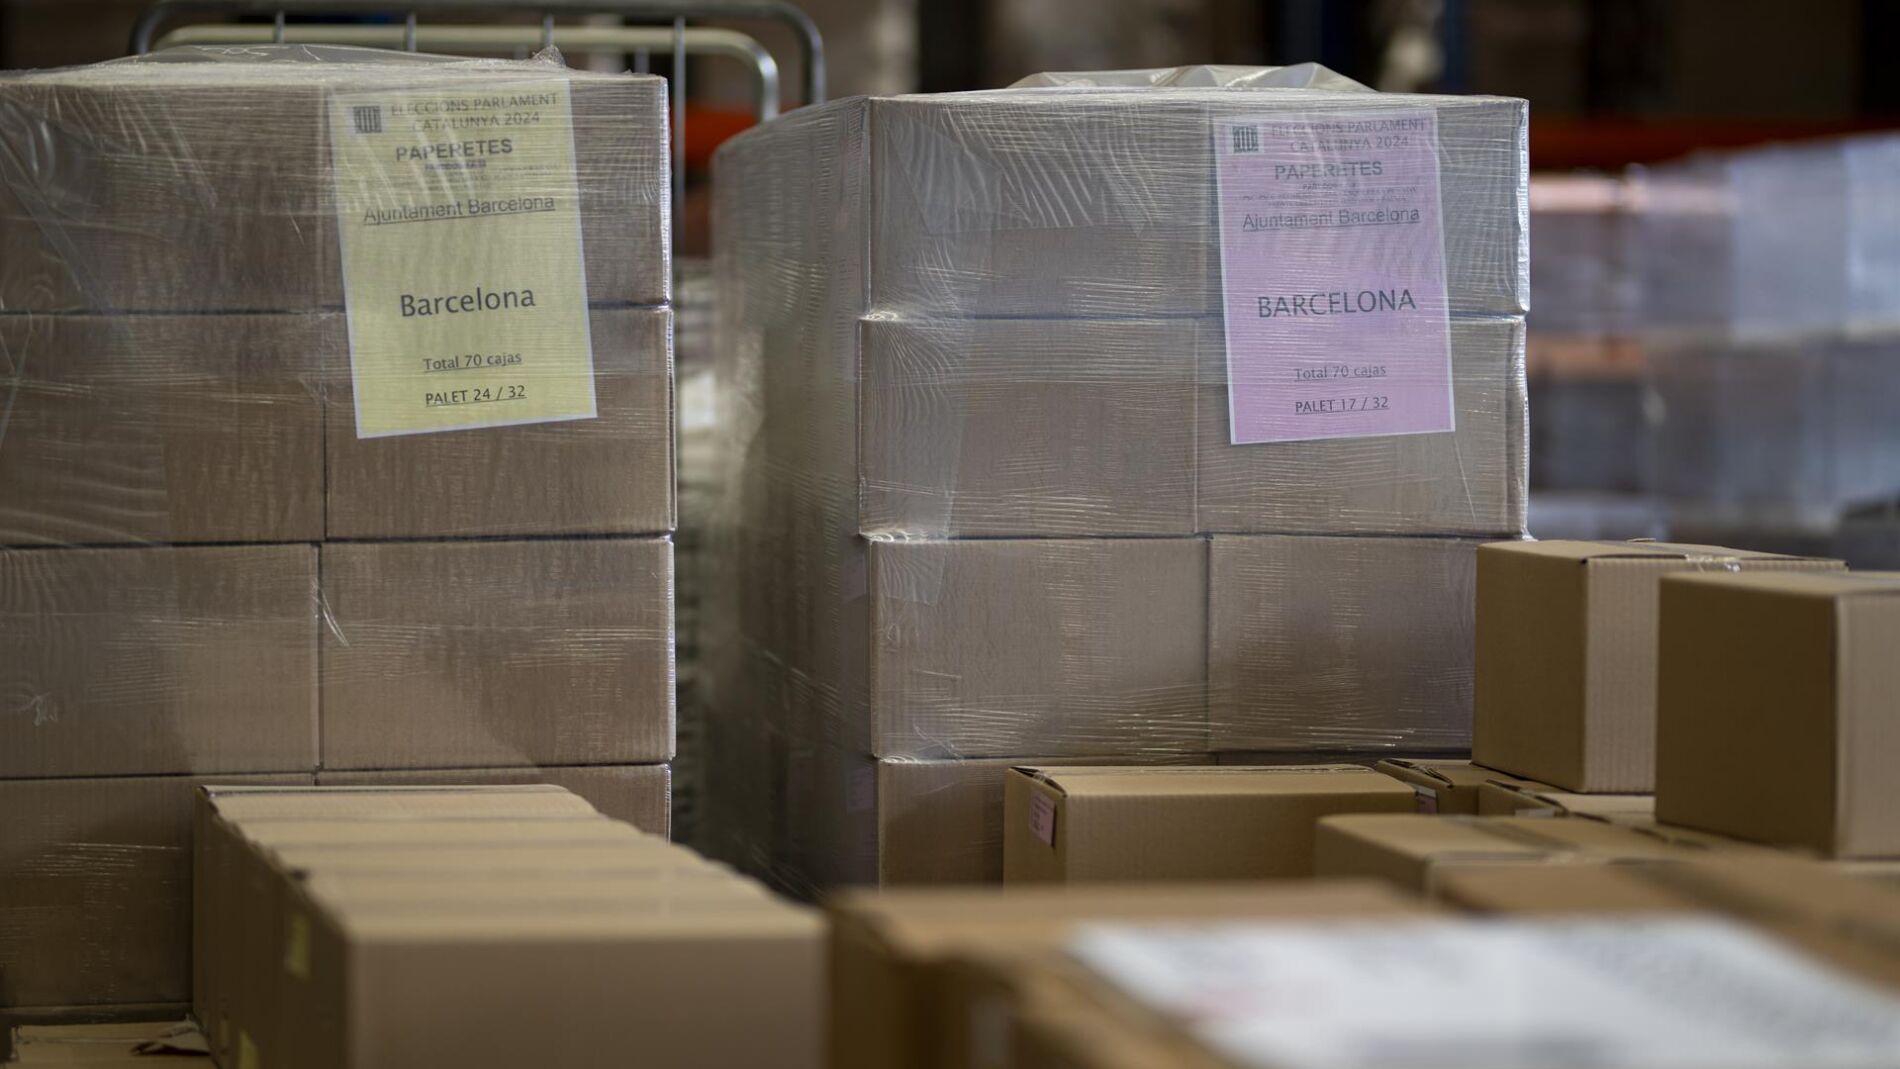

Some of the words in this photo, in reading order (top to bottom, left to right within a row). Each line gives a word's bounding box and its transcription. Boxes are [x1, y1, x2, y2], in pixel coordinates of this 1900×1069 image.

[474, 93, 558, 111] PARLAMENT
[412, 116, 500, 132] CATALUNYA
[504, 112, 540, 126] 2024
[1347, 118, 1425, 133] PARLAMENT
[396, 139, 513, 161] PAPERETES
[1376, 135, 1409, 149] 2024
[1274, 161, 1383, 180] PAPERETES
[364, 201, 462, 224] Ajuntament
[468, 196, 555, 215] Barcelona
[1243, 212, 1333, 232] Ajuntament
[1339, 207, 1420, 225] Barcelona
[401, 287, 536, 317] Barcelona
[1258, 288, 1416, 318] BARCELONA
[423, 356, 459, 371] Total
[465, 354, 482, 367] 70
[487, 353, 522, 367] cajas
[1294, 367, 1328, 381] Total
[1333, 365, 1349, 378] 70
[1354, 364, 1387, 378] cajas
[426, 389, 467, 405] PALET
[473, 388, 491, 401] 24
[508, 385, 526, 399] 32
[1295, 399, 1335, 413] PALET
[1342, 398, 1357, 411] 17
[1373, 396, 1389, 409] 32
